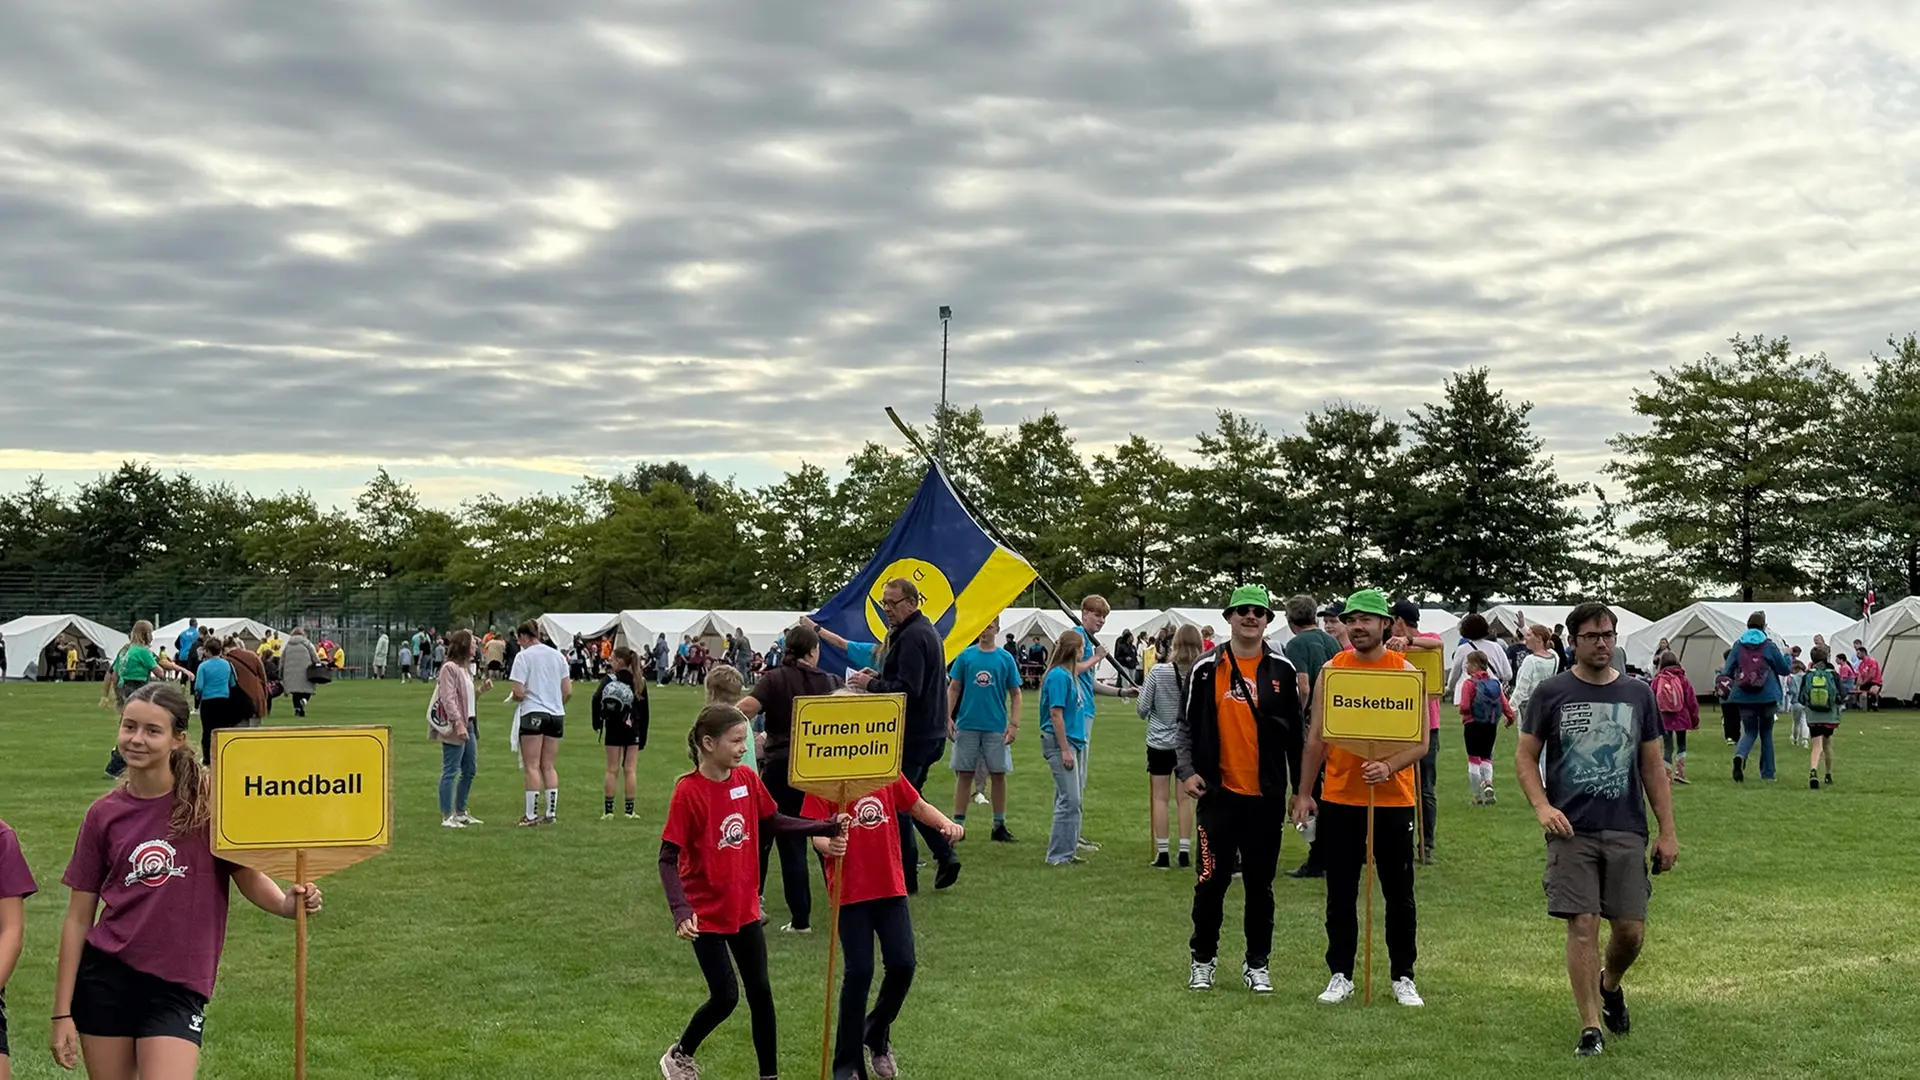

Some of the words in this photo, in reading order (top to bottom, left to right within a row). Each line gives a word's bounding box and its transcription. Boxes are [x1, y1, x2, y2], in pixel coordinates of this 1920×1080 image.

[1333, 694, 1414, 711] Basketball
[801, 720, 860, 736] Turnen
[865, 717, 897, 734] und
[805, 740, 889, 760] Trampolin
[244, 773, 362, 797] Handball
[1200, 830, 1210, 876] VIKINGS
